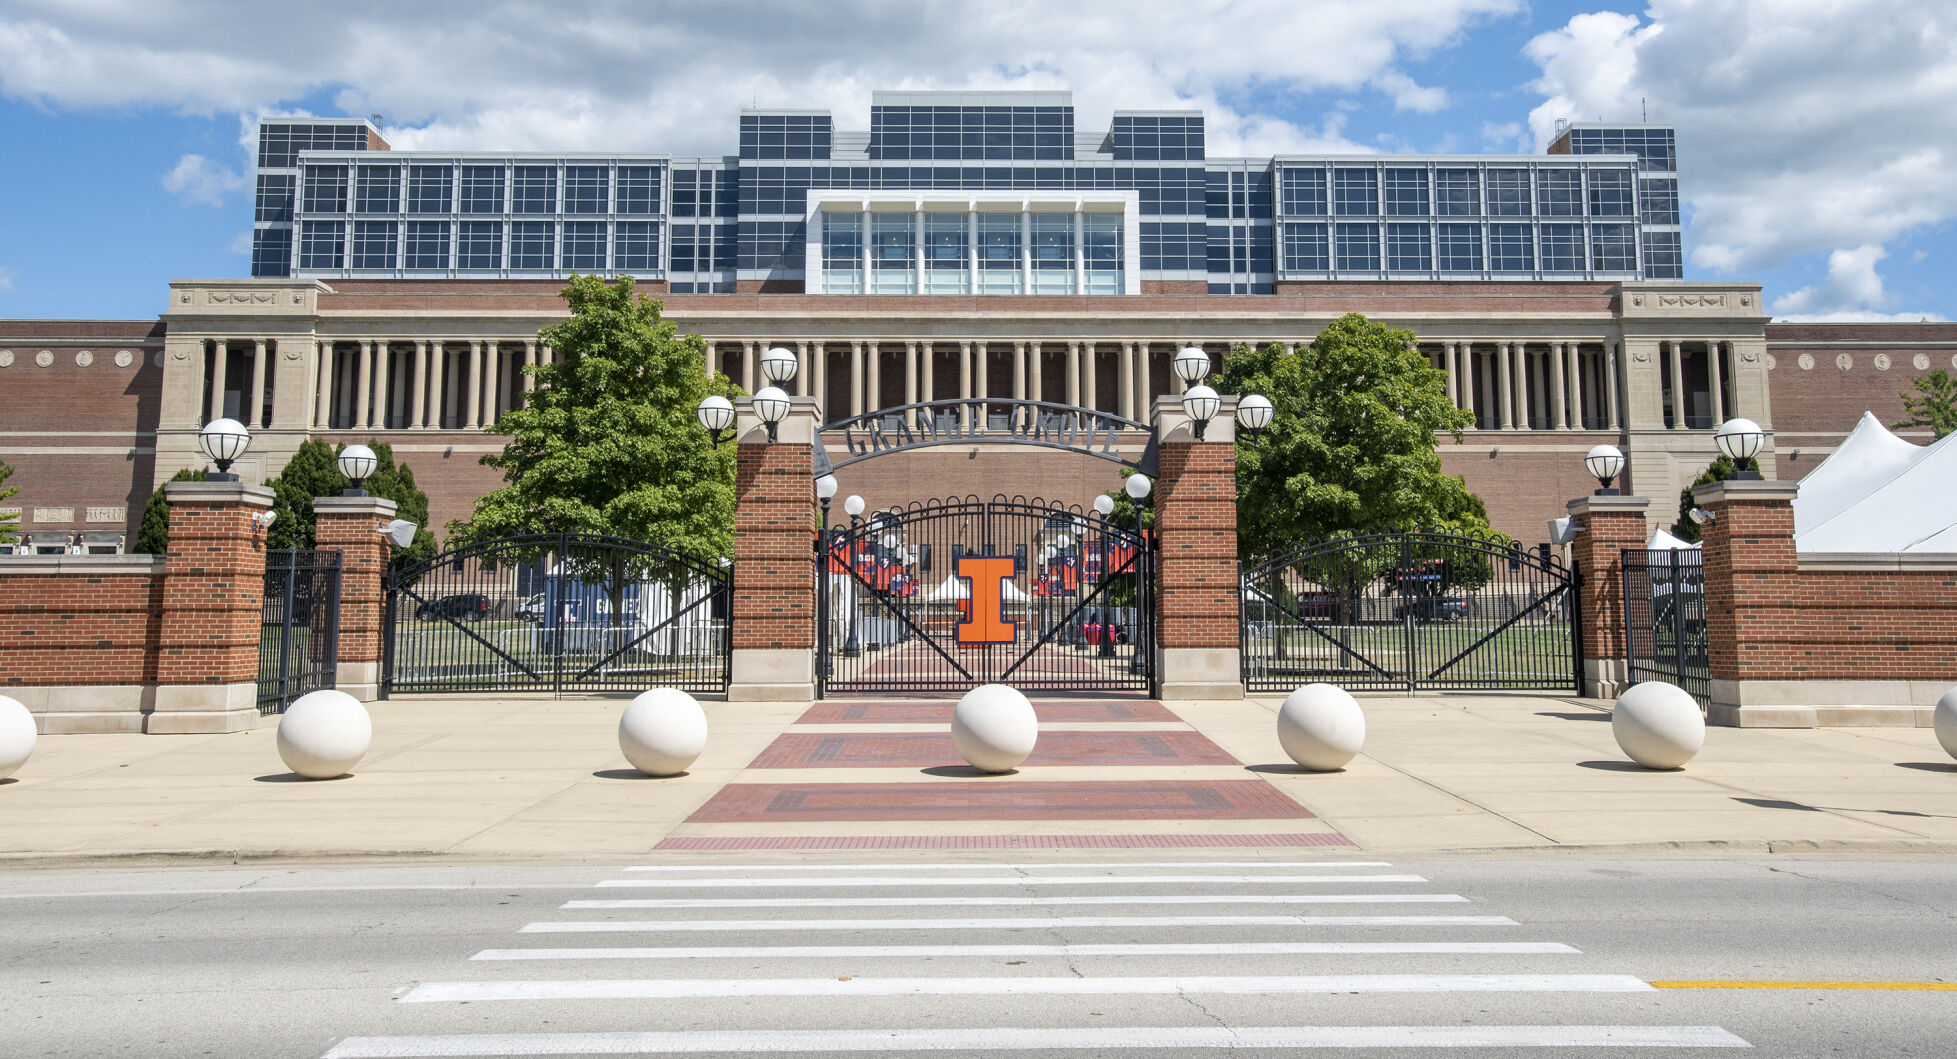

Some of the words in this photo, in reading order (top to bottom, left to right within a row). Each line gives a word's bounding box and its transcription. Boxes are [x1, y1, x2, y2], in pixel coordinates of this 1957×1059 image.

[845, 402, 985, 457] GRANGE
[1010, 402, 1125, 457] GROVE
[956, 555, 1017, 644] I
